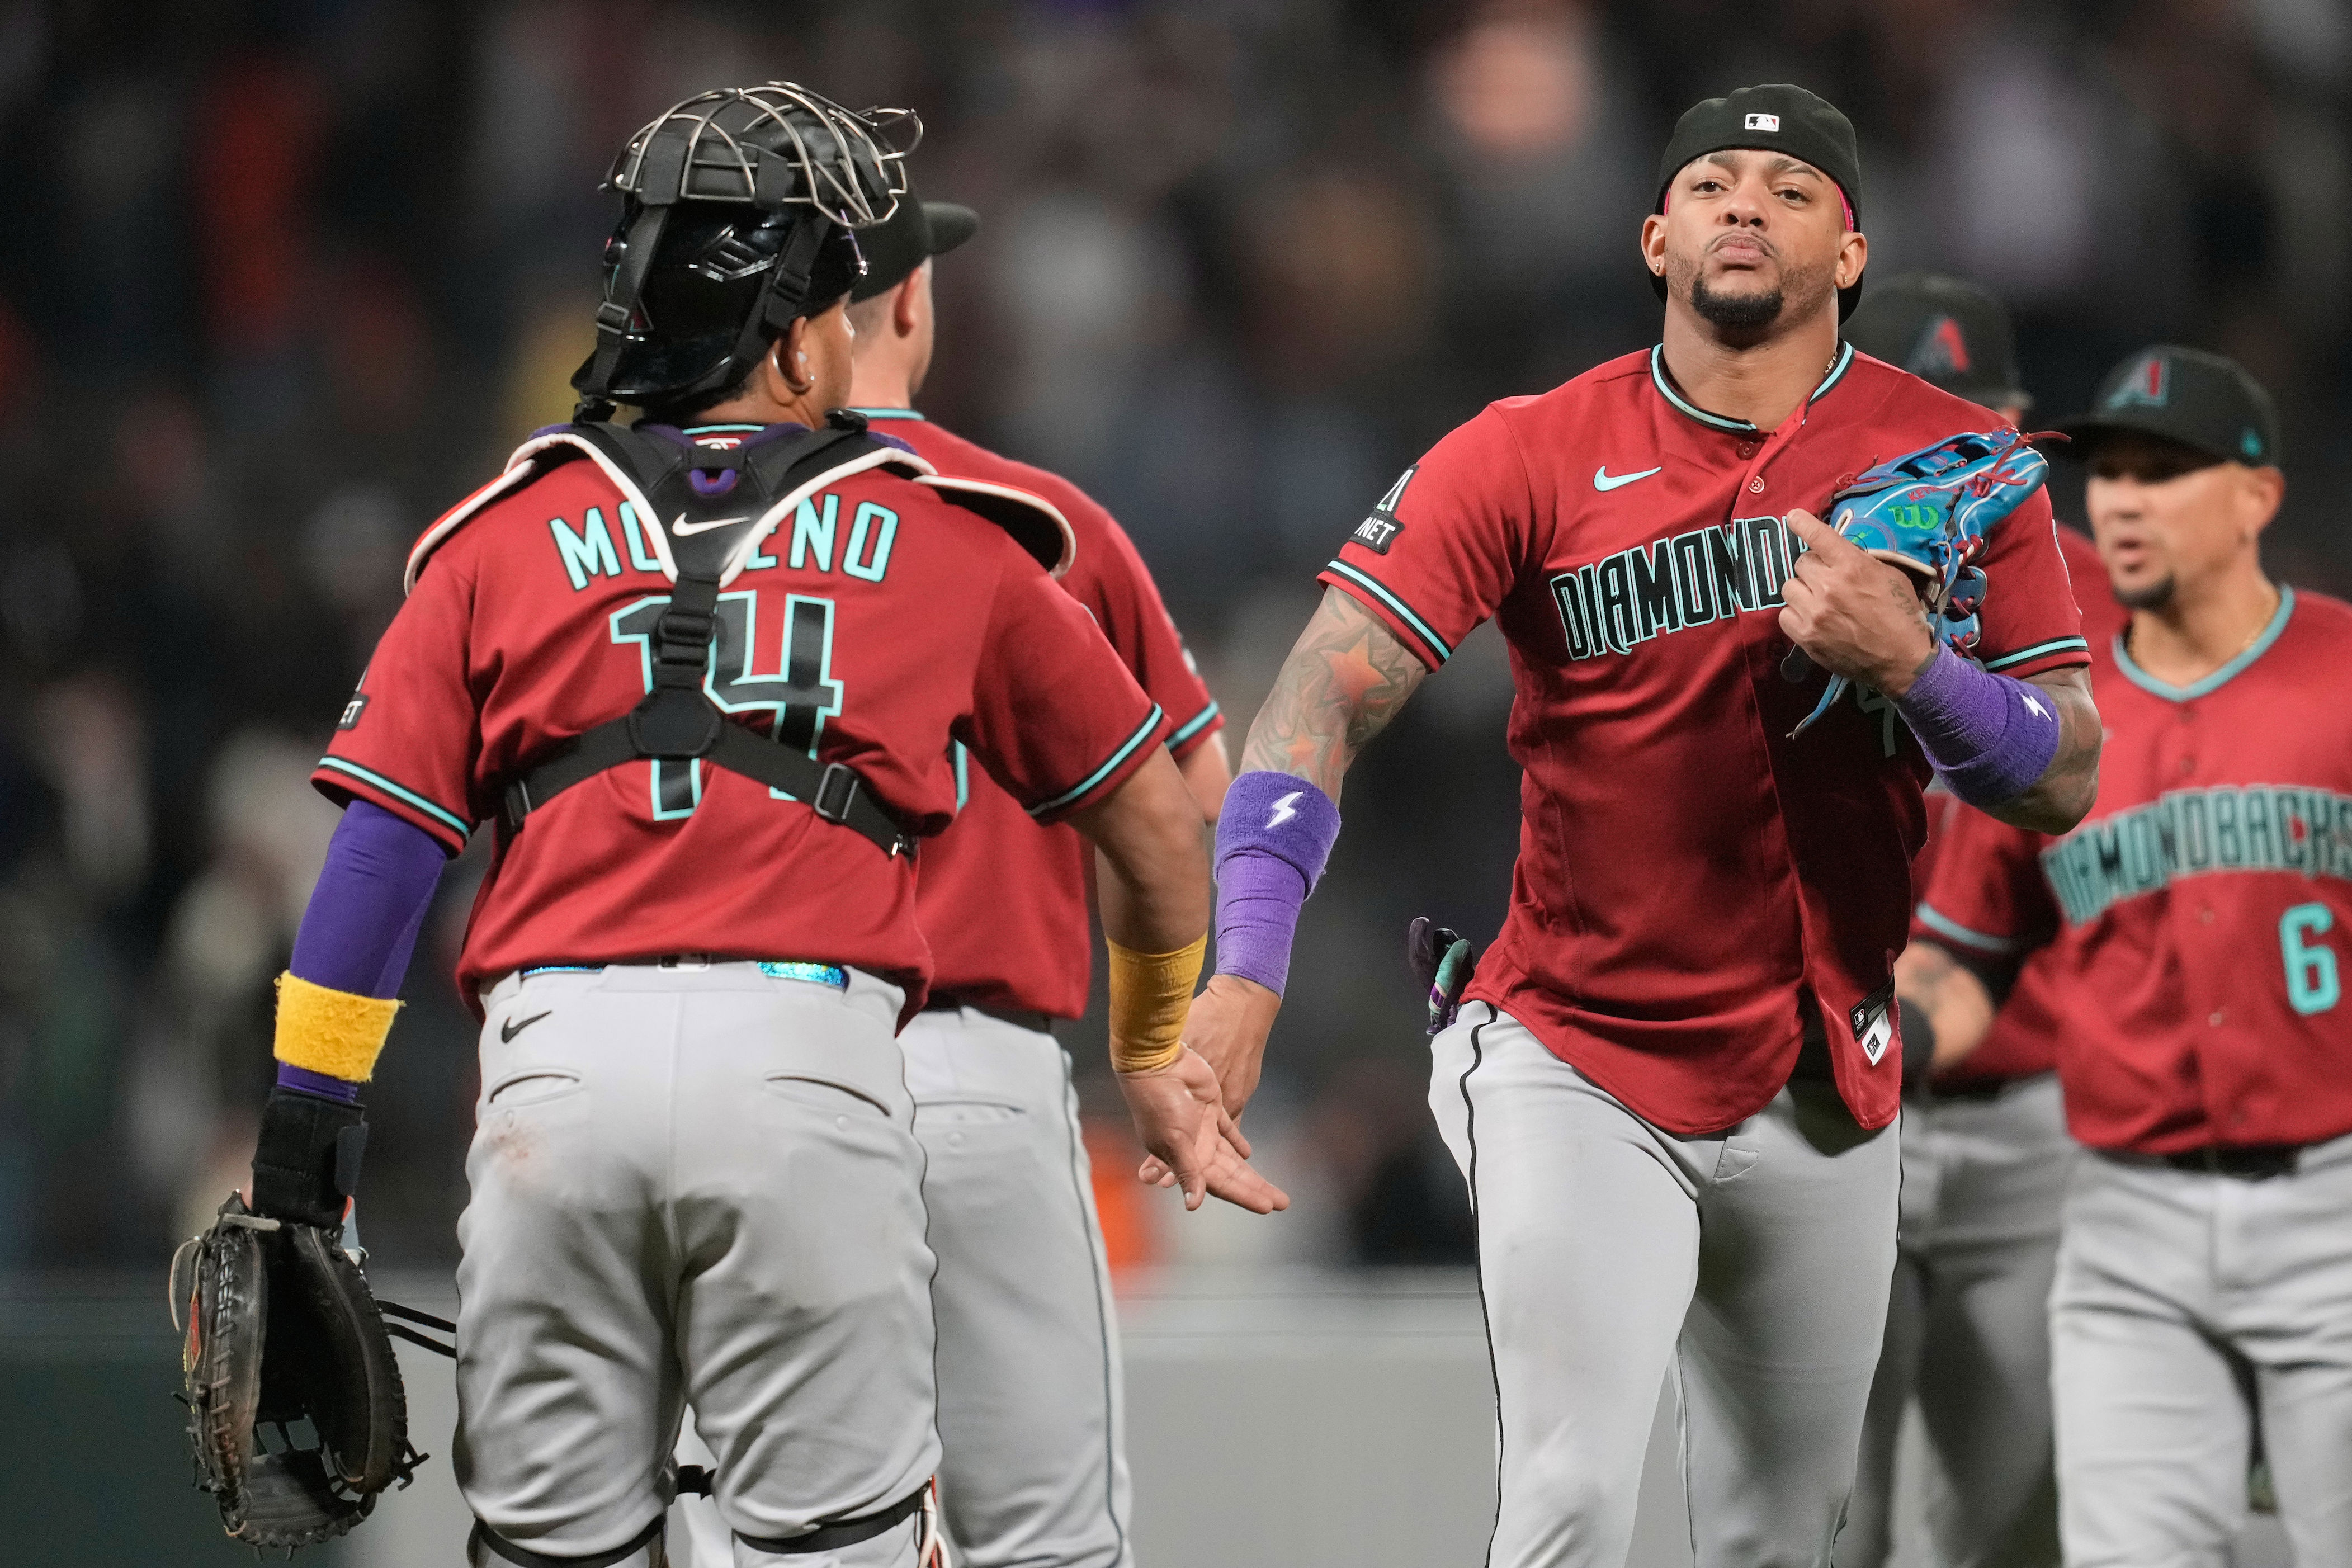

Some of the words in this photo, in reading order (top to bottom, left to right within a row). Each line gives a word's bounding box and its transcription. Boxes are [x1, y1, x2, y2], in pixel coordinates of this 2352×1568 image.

[550, 494, 898, 591] MONO
[1354, 517, 1396, 545] NET
[610, 589, 844, 821] 14
[2278, 901, 2341, 1017] 6
